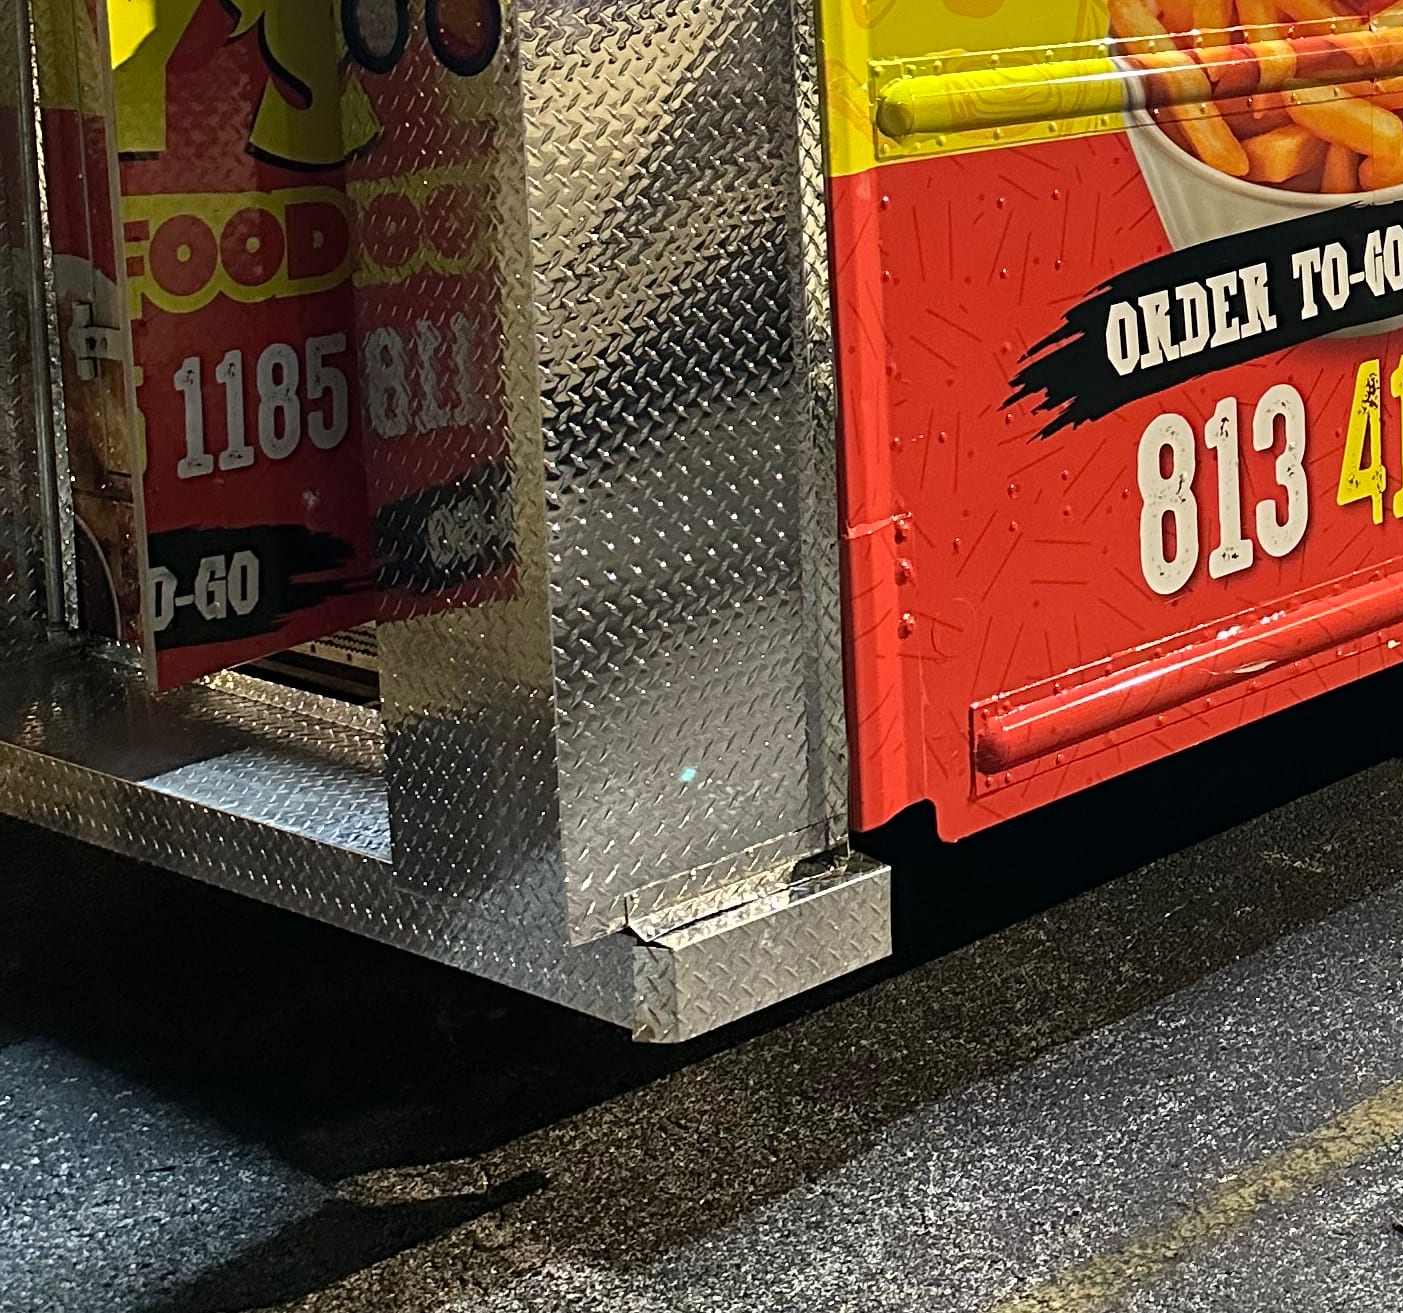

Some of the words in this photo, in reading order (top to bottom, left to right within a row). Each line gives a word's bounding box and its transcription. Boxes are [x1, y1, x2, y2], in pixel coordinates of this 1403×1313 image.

[1105, 267, 1278, 376] ORDER
[174, 332, 350, 480] 1185
[1137, 383, 1309, 595] 813
